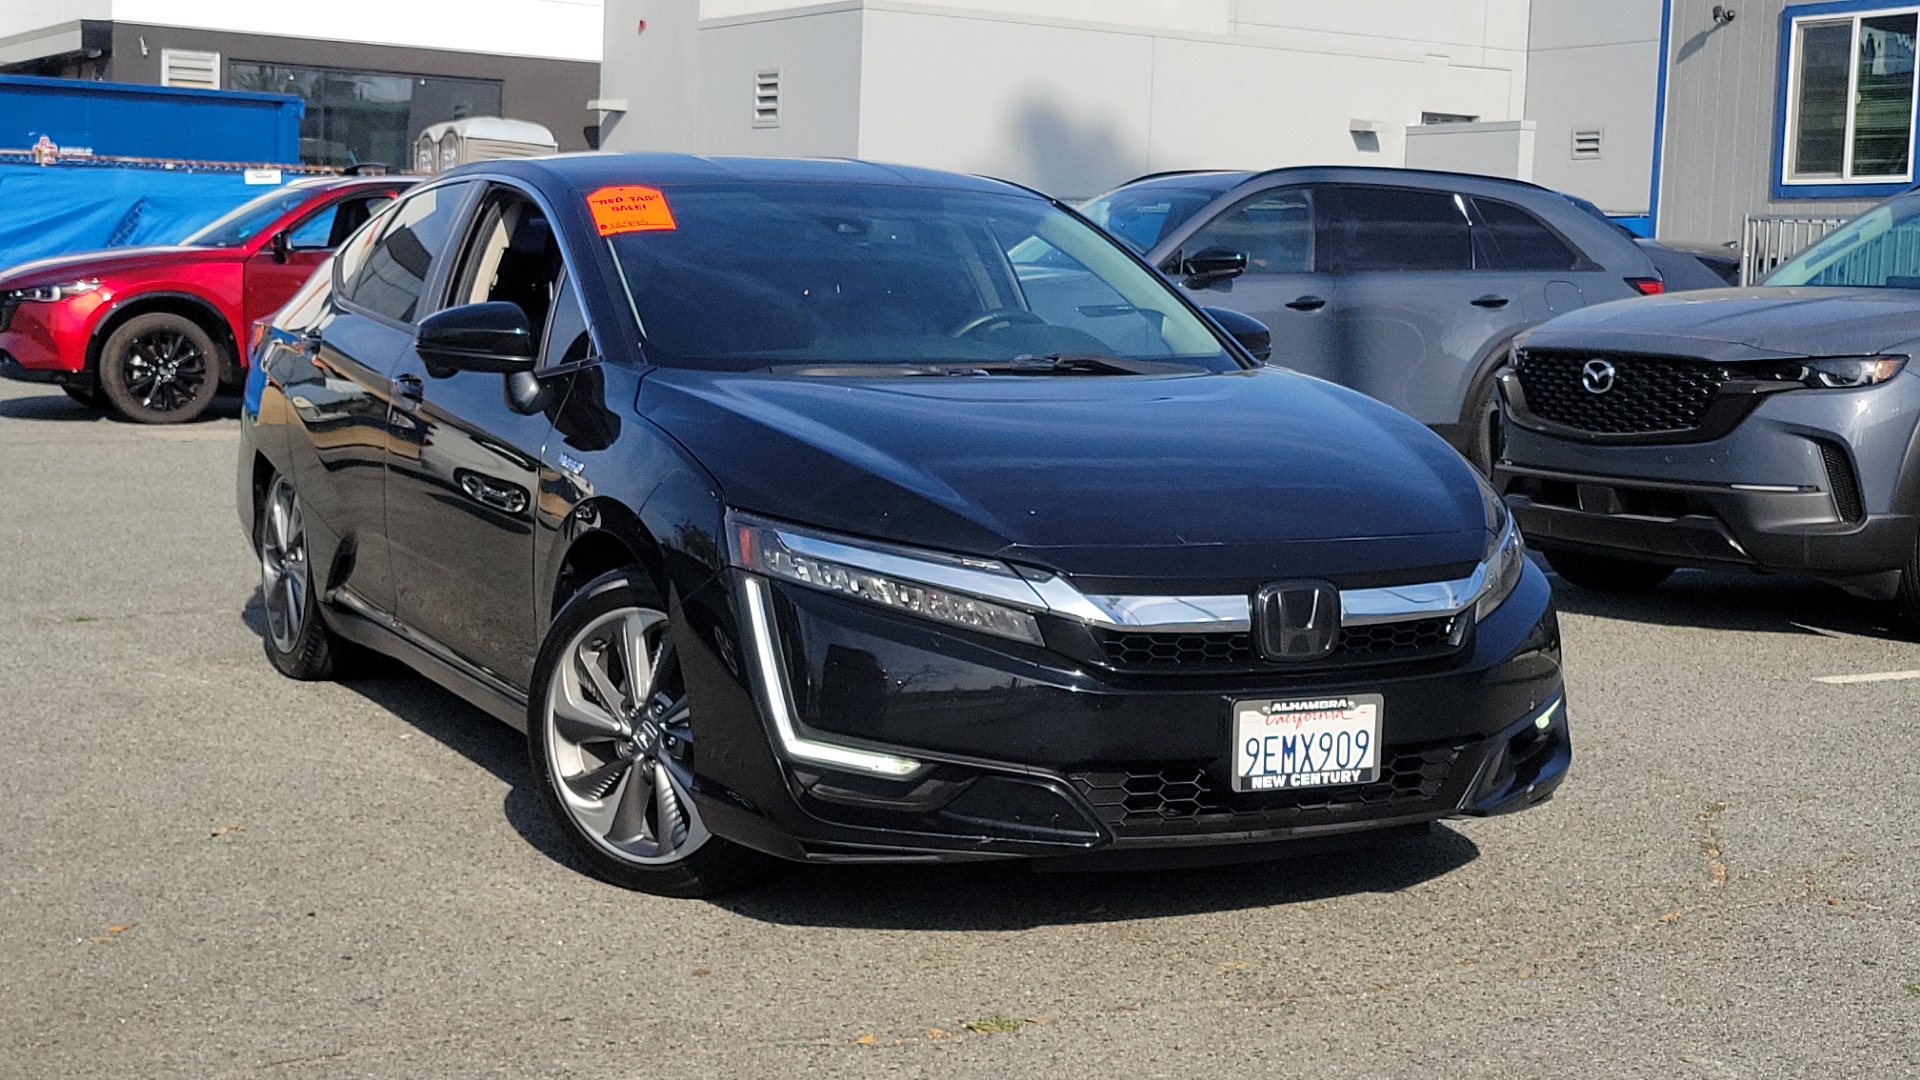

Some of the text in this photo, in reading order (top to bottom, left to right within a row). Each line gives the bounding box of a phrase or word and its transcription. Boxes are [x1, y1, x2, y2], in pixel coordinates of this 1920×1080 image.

[1271, 699, 1347, 712] ALHAMBRA
[1245, 729, 1370, 776] 9EMX909
[1251, 770, 1362, 789] NEW CENTURY
